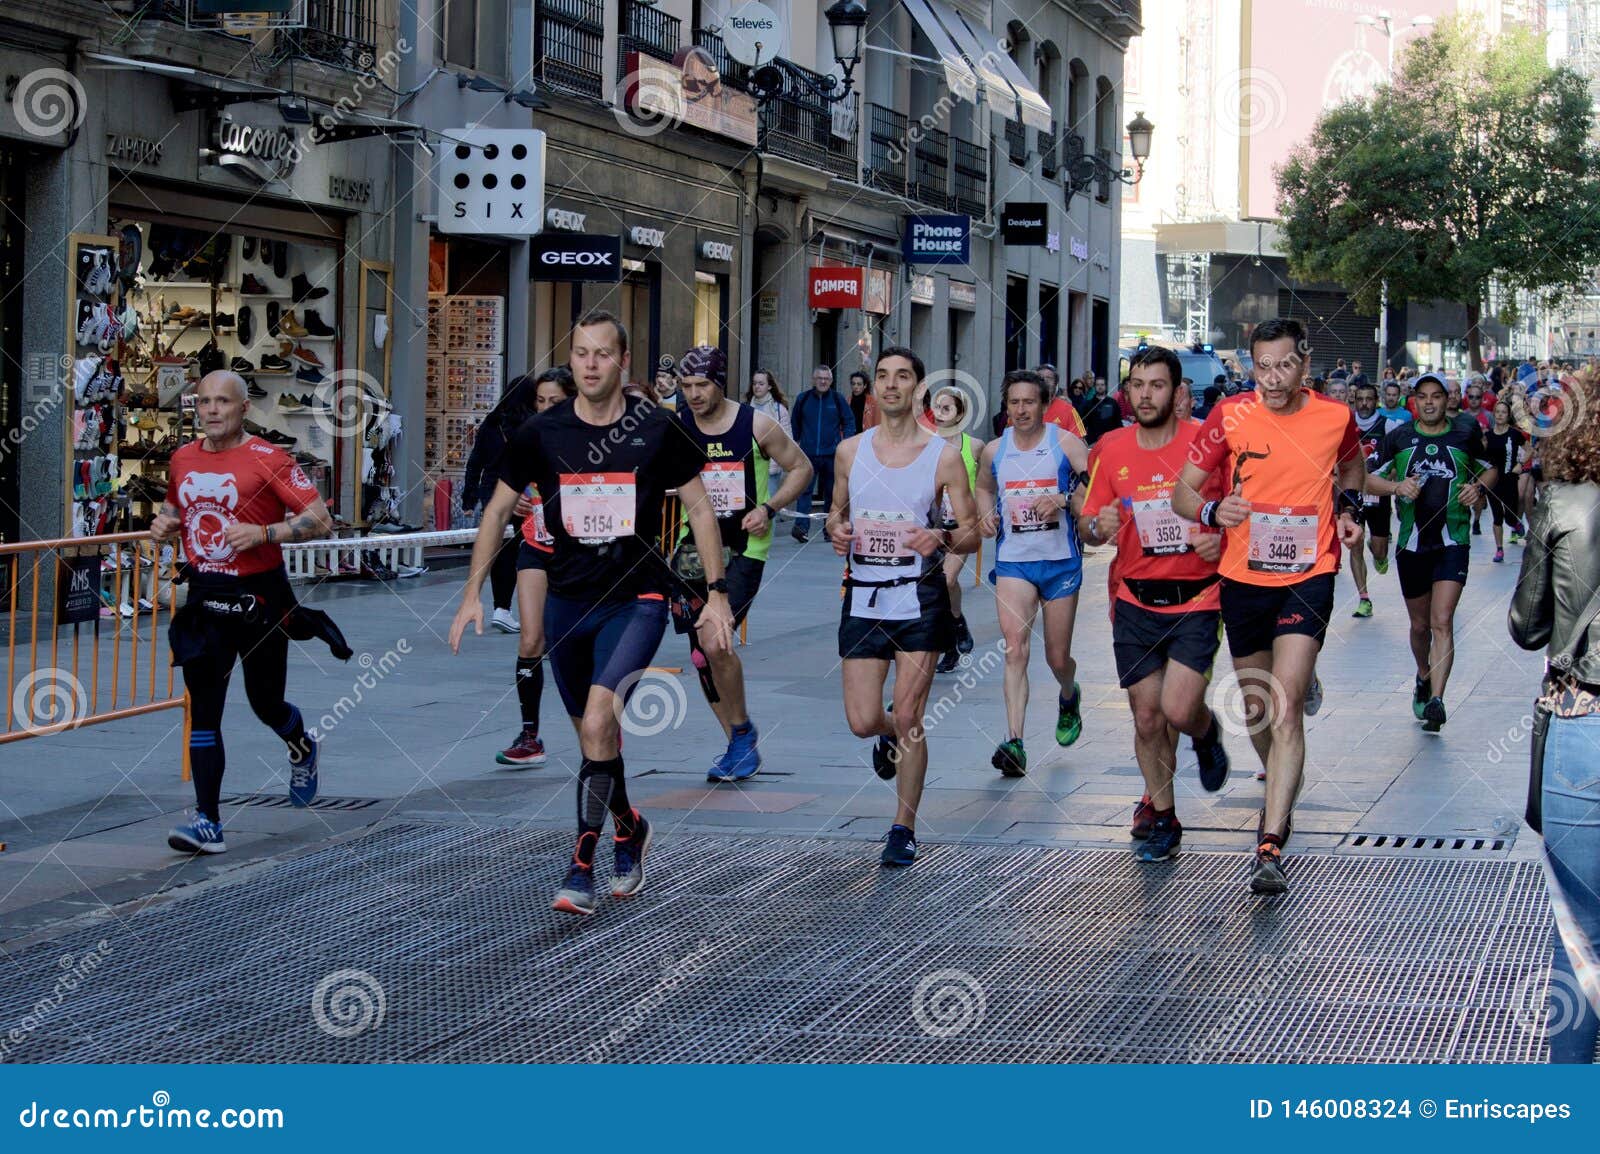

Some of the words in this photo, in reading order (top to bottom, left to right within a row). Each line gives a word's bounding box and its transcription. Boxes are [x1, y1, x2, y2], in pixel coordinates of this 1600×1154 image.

[730, 17, 773, 29] Televés
[105, 134, 164, 165] ZAPATOS
[454, 202, 524, 218] SIX
[549, 208, 586, 232] GEOX
[634, 226, 665, 249] GEOX
[913, 223, 962, 237] Phone
[706, 241, 733, 261] GEOX
[913, 238, 962, 251] House
[541, 251, 613, 266] GEOX
[814, 279, 858, 296] CAMPER
[709, 494, 729, 508] 854
[584, 515, 613, 533] 5154
[1155, 525, 1182, 542] 3582
[869, 537, 896, 554] 2756
[1268, 543, 1297, 560] 3448
